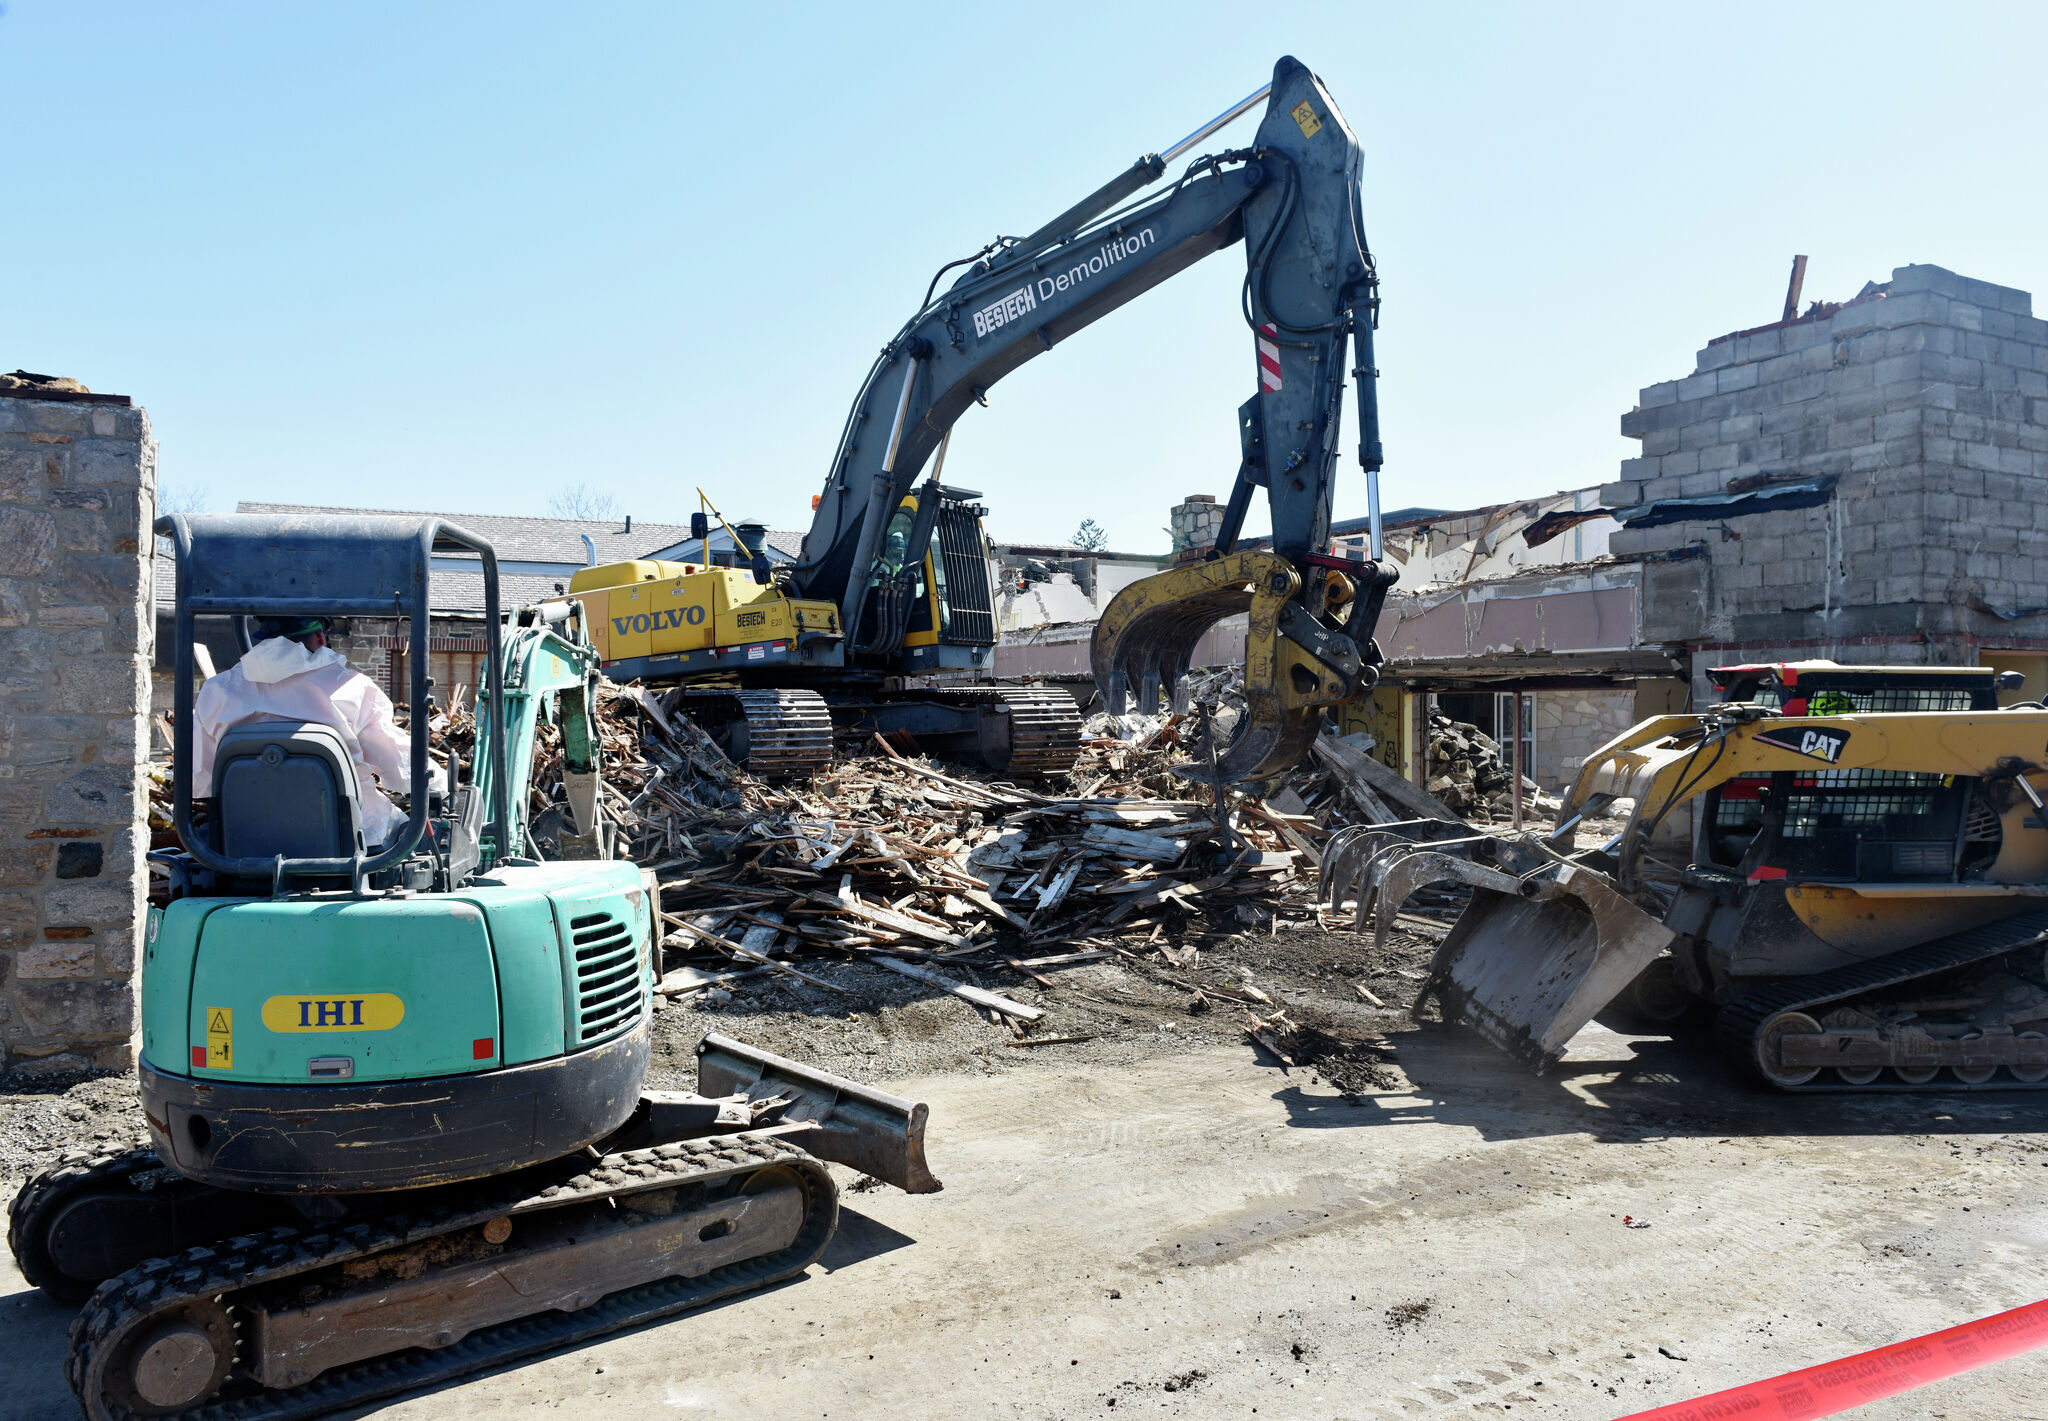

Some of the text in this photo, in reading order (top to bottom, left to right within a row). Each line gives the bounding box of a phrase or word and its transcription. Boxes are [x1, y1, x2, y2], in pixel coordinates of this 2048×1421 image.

[973, 228, 1155, 338] BESTECH Demolition
[612, 605, 706, 636] VOLVO
[737, 611, 765, 628] BESTECH
[1800, 730, 1841, 762] CAT
[298, 1000, 365, 1027] IHI
